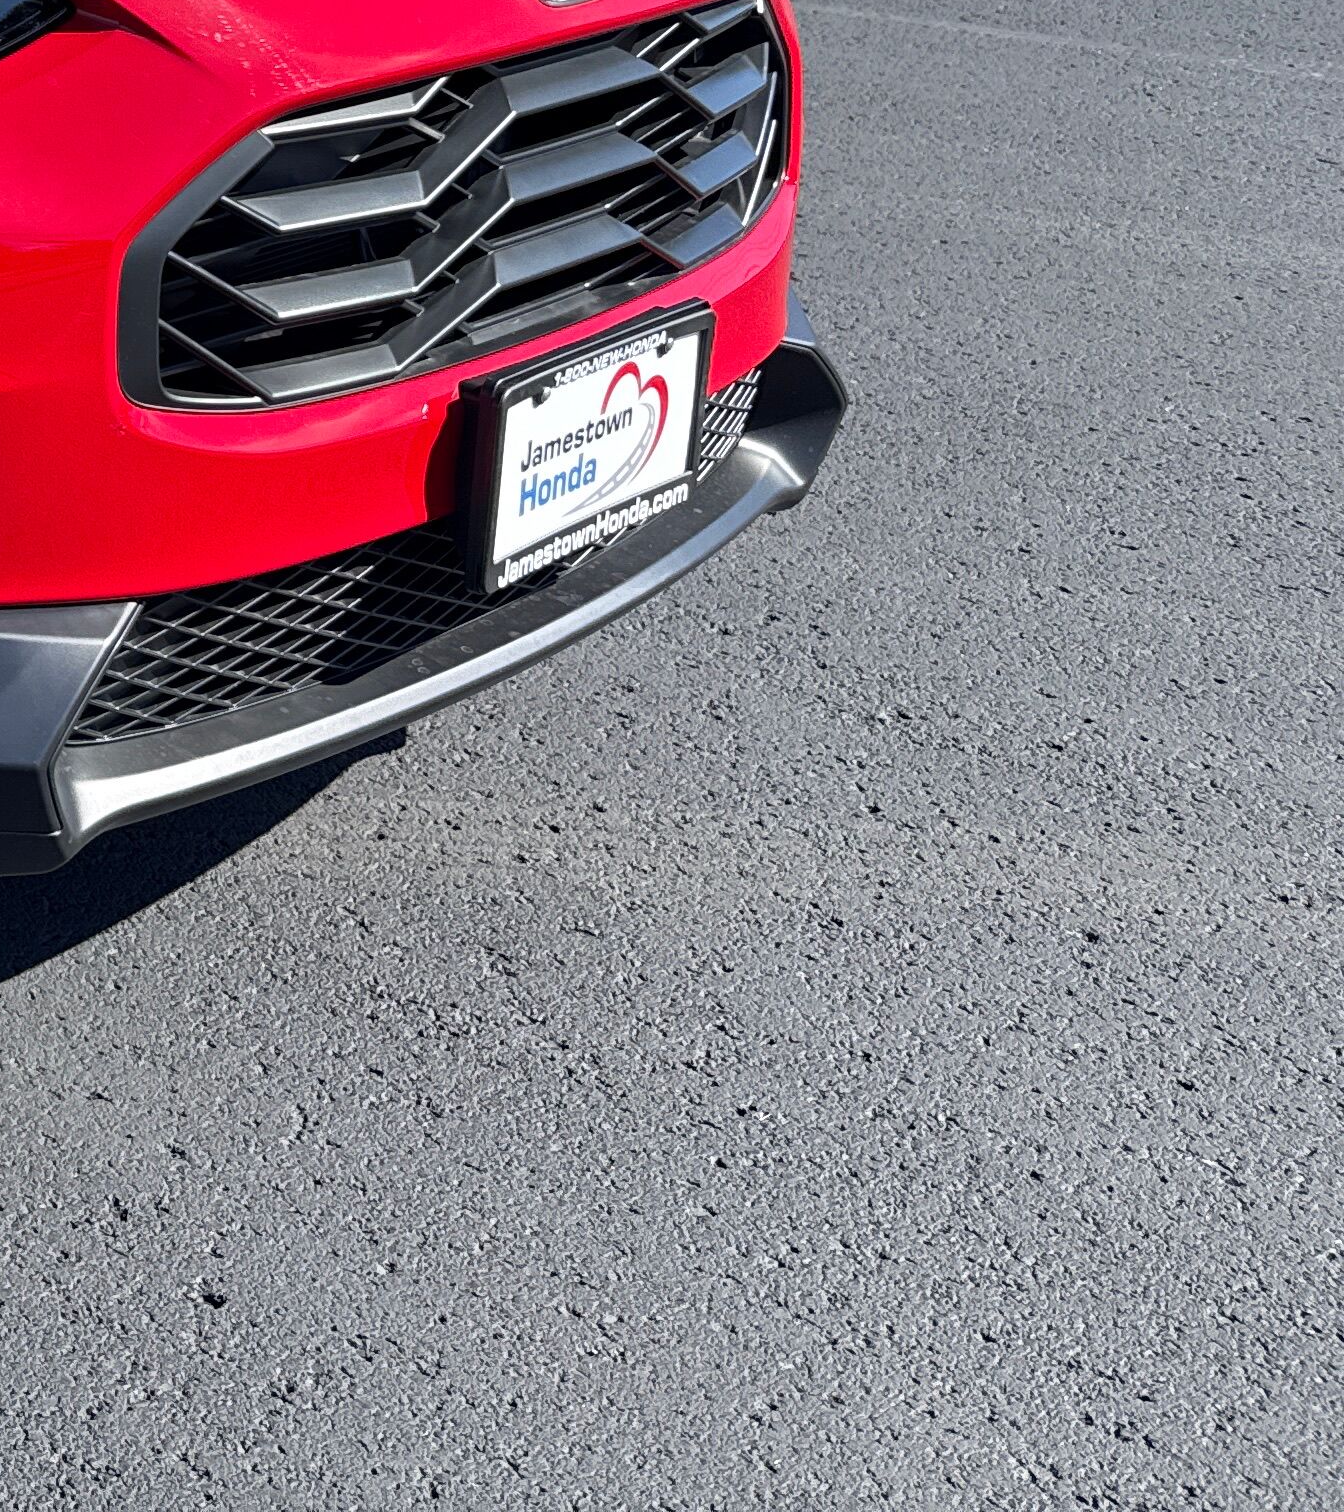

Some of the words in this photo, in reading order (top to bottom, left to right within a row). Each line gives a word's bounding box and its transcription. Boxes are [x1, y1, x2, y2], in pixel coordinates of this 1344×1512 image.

[520, 406, 633, 472] Jamestown
[518, 453, 598, 516] Honda
[497, 482, 690, 588] JamestownHonda.com
